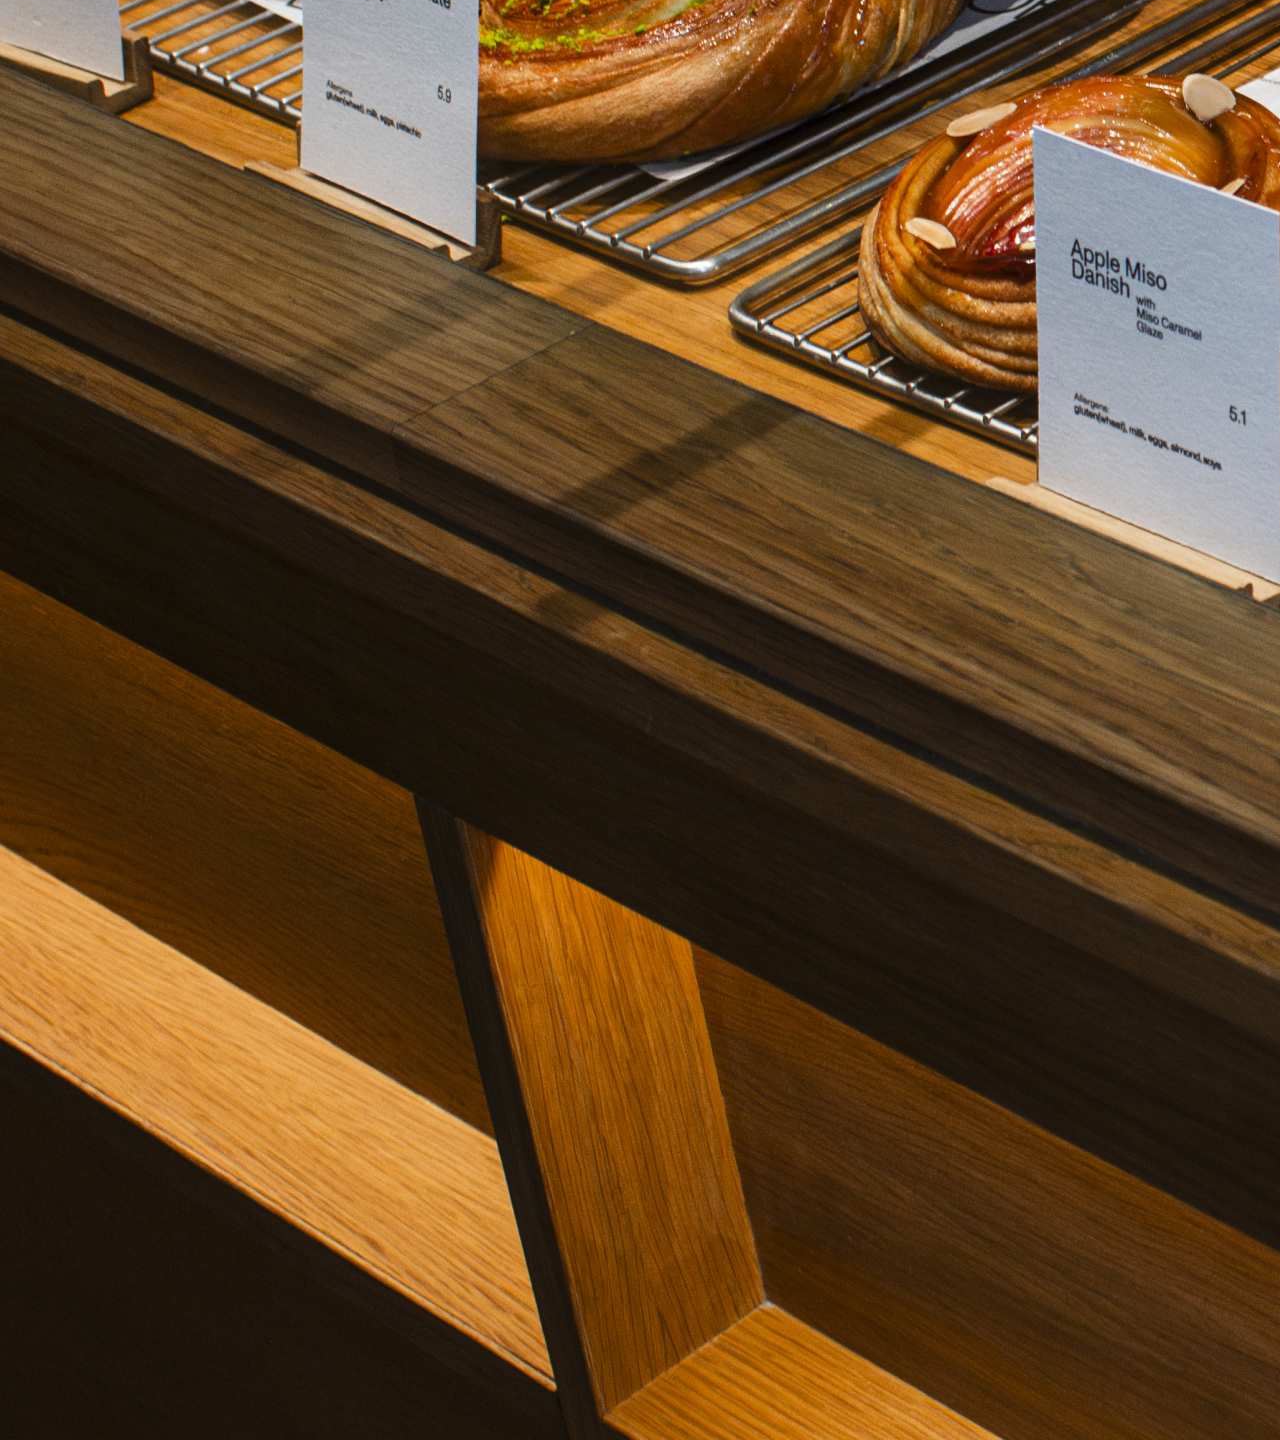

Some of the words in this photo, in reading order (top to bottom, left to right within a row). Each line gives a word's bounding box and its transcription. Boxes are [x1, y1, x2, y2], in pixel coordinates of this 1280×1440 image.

[437, 84, 452, 104] 5.9
[1071, 238, 1120, 273] Apple
[1125, 256, 1168, 291] Miso
[1072, 258, 1131, 298] Danish
[1136, 296, 1156, 310] with
[1136, 307, 1160, 326] Miso
[1161, 316, 1202, 341] Caramel
[1136, 320, 1164, 340] Glaze
[1229, 404, 1247, 426] 5.1
